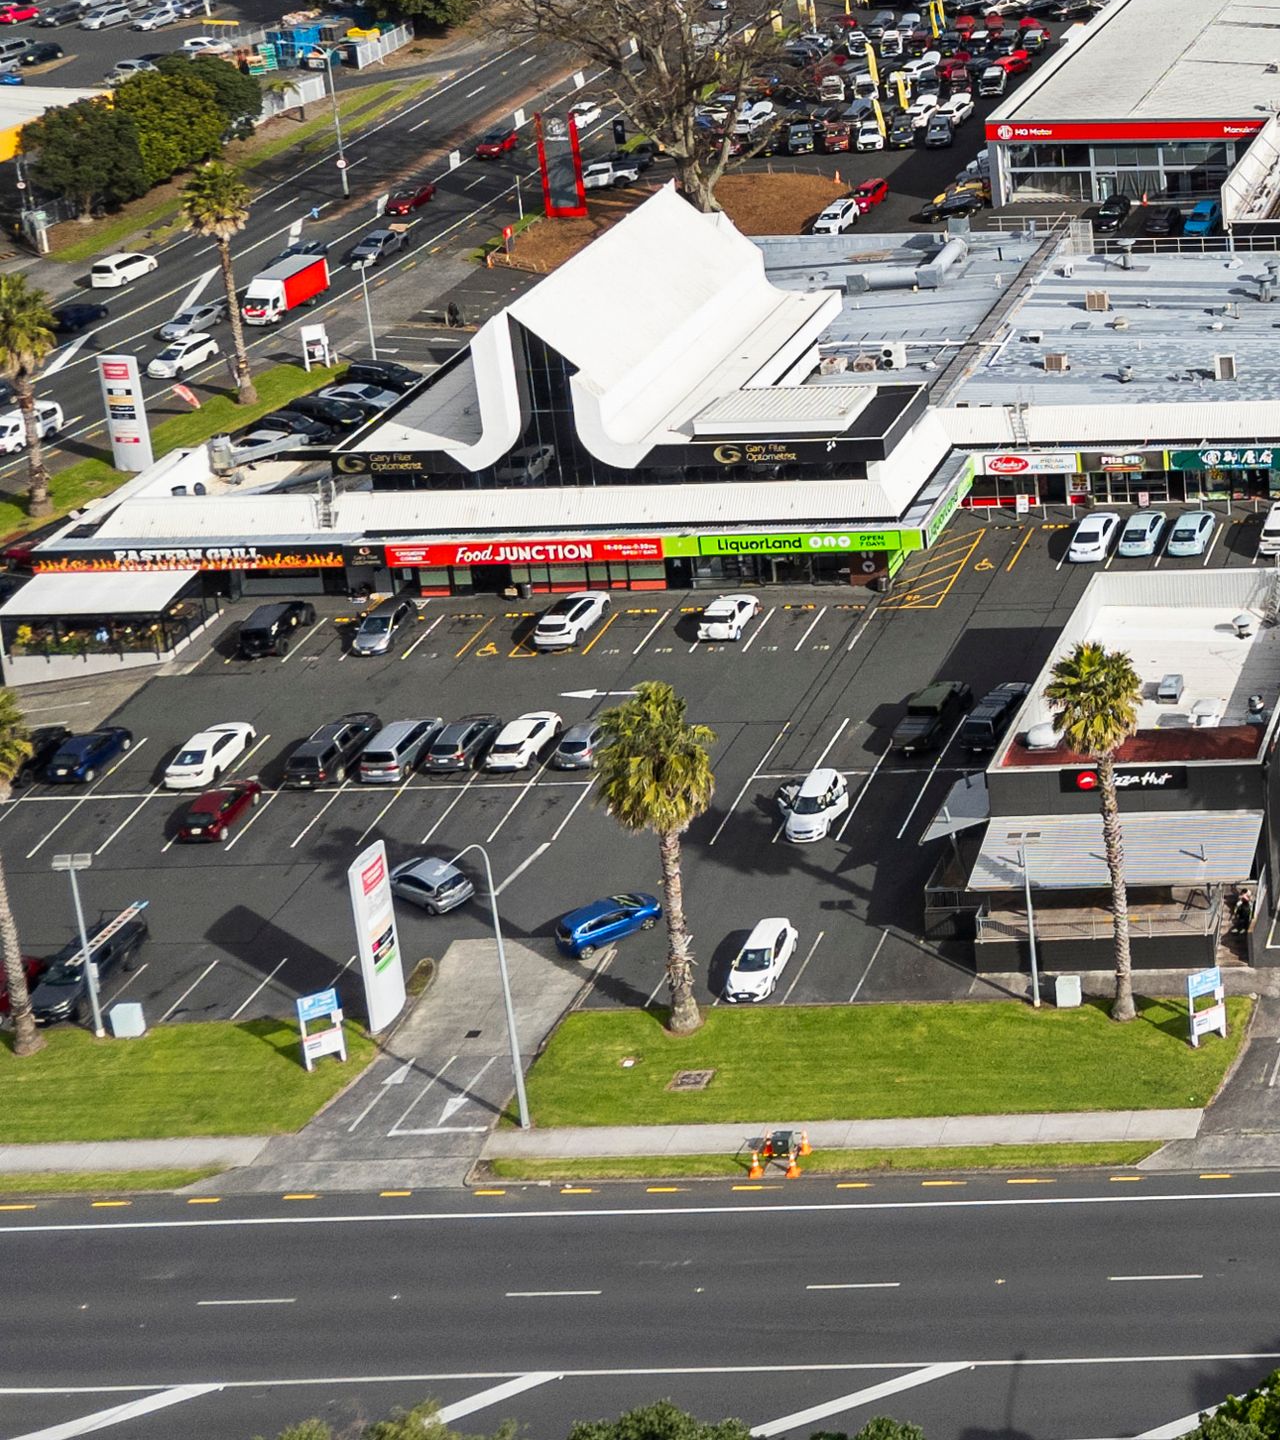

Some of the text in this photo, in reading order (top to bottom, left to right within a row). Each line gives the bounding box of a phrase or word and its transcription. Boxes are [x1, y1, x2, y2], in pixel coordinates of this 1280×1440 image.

[1014, 128, 1028, 136] MG
[1029, 128, 1052, 136] Motor
[745, 444, 766, 454] Gary
[369, 453, 391, 463] Gary
[746, 451, 797, 462] Optometrist
[1101, 455, 1140, 464] Pita Pit
[370, 462, 424, 472] Optometrist
[113, 547, 260, 561] EASTERN GRILL
[456, 543, 593, 563] Food JUNCTION
[1111, 771, 1172, 786] izza Hut
